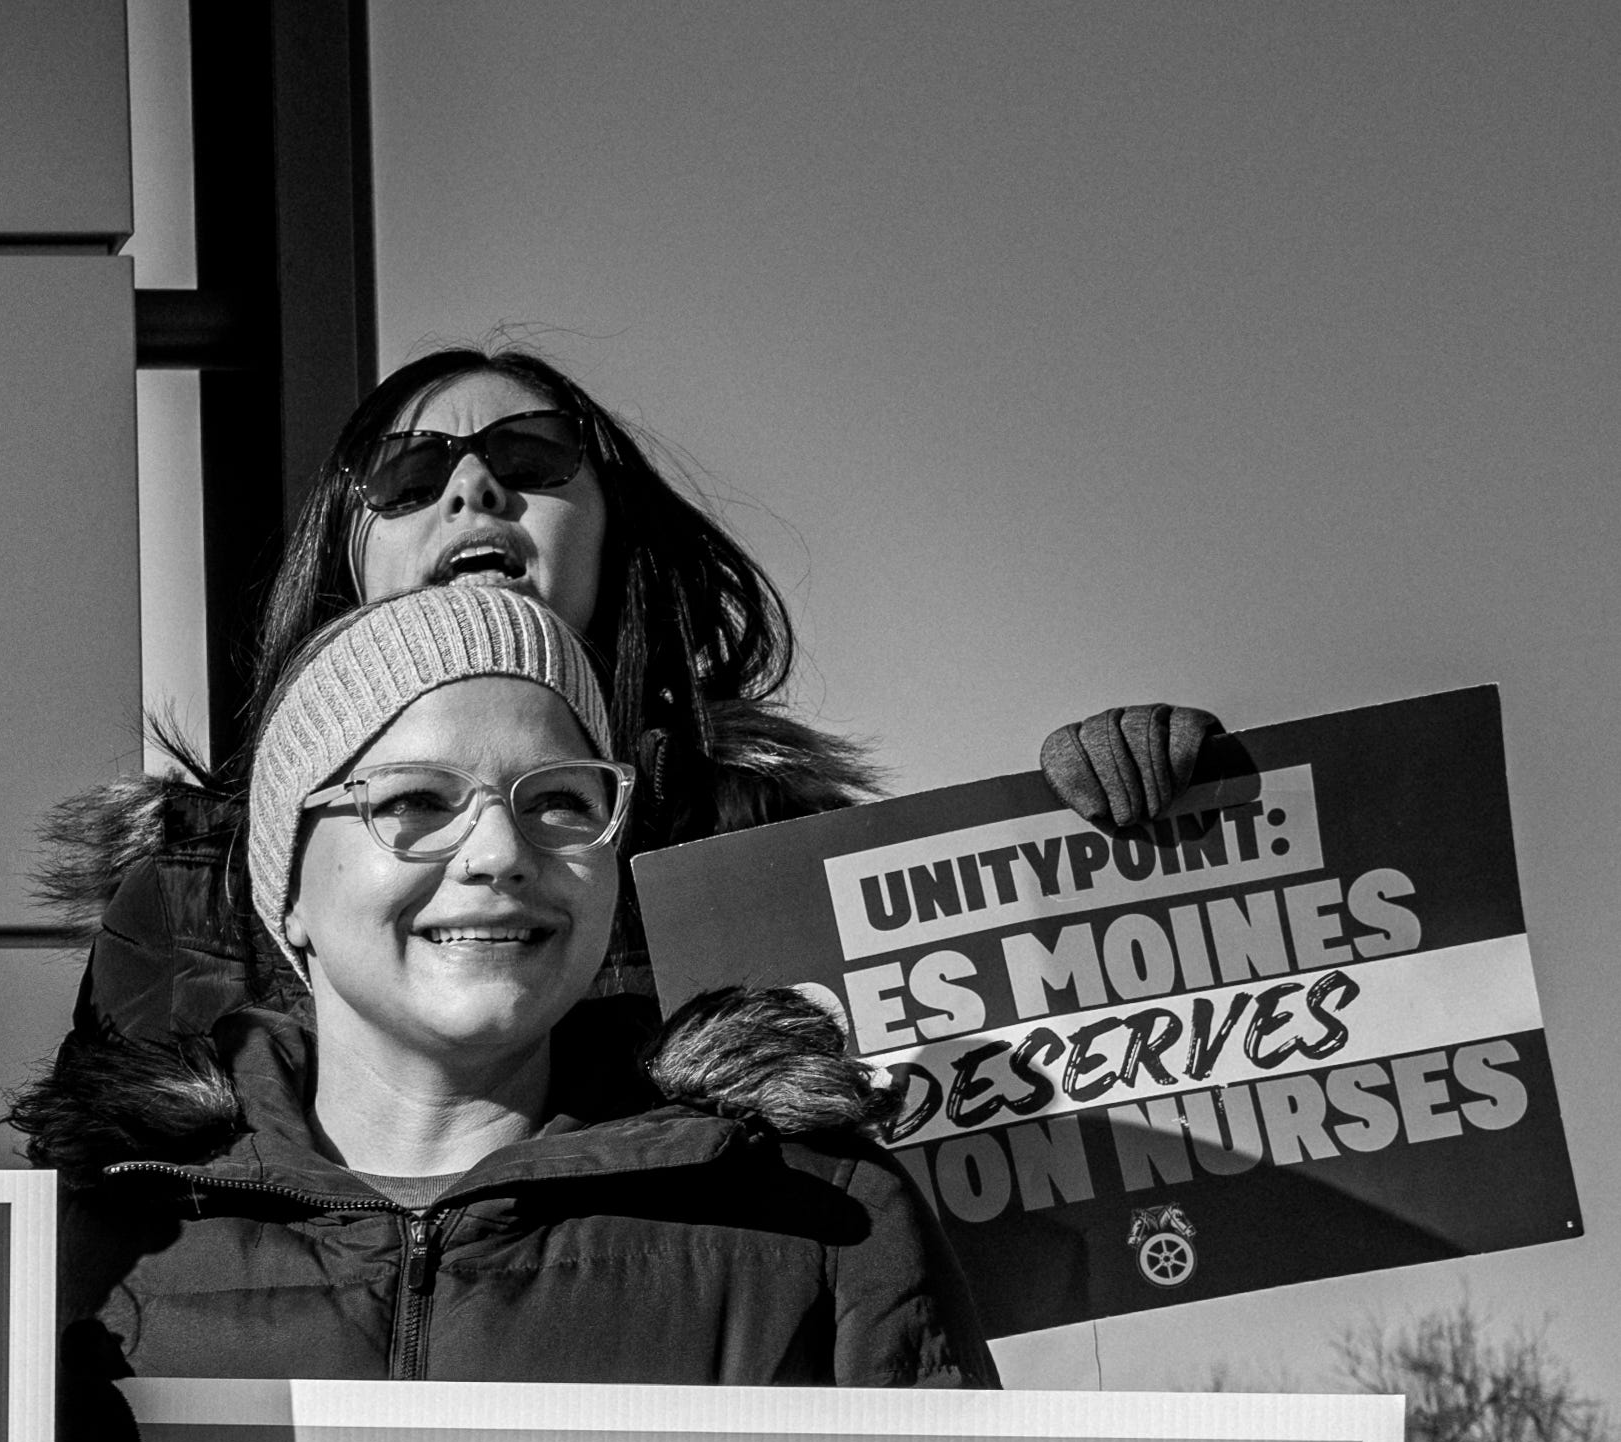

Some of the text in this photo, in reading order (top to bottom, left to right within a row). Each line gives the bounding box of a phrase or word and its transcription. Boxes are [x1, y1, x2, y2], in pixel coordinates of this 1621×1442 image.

[859, 800, 1293, 933] UNITYPOINT:
[1000, 867, 1422, 1018] MOINES
[882, 970, 1362, 1147] DESERVES
[1115, 1039, 1530, 1194] NURSES
